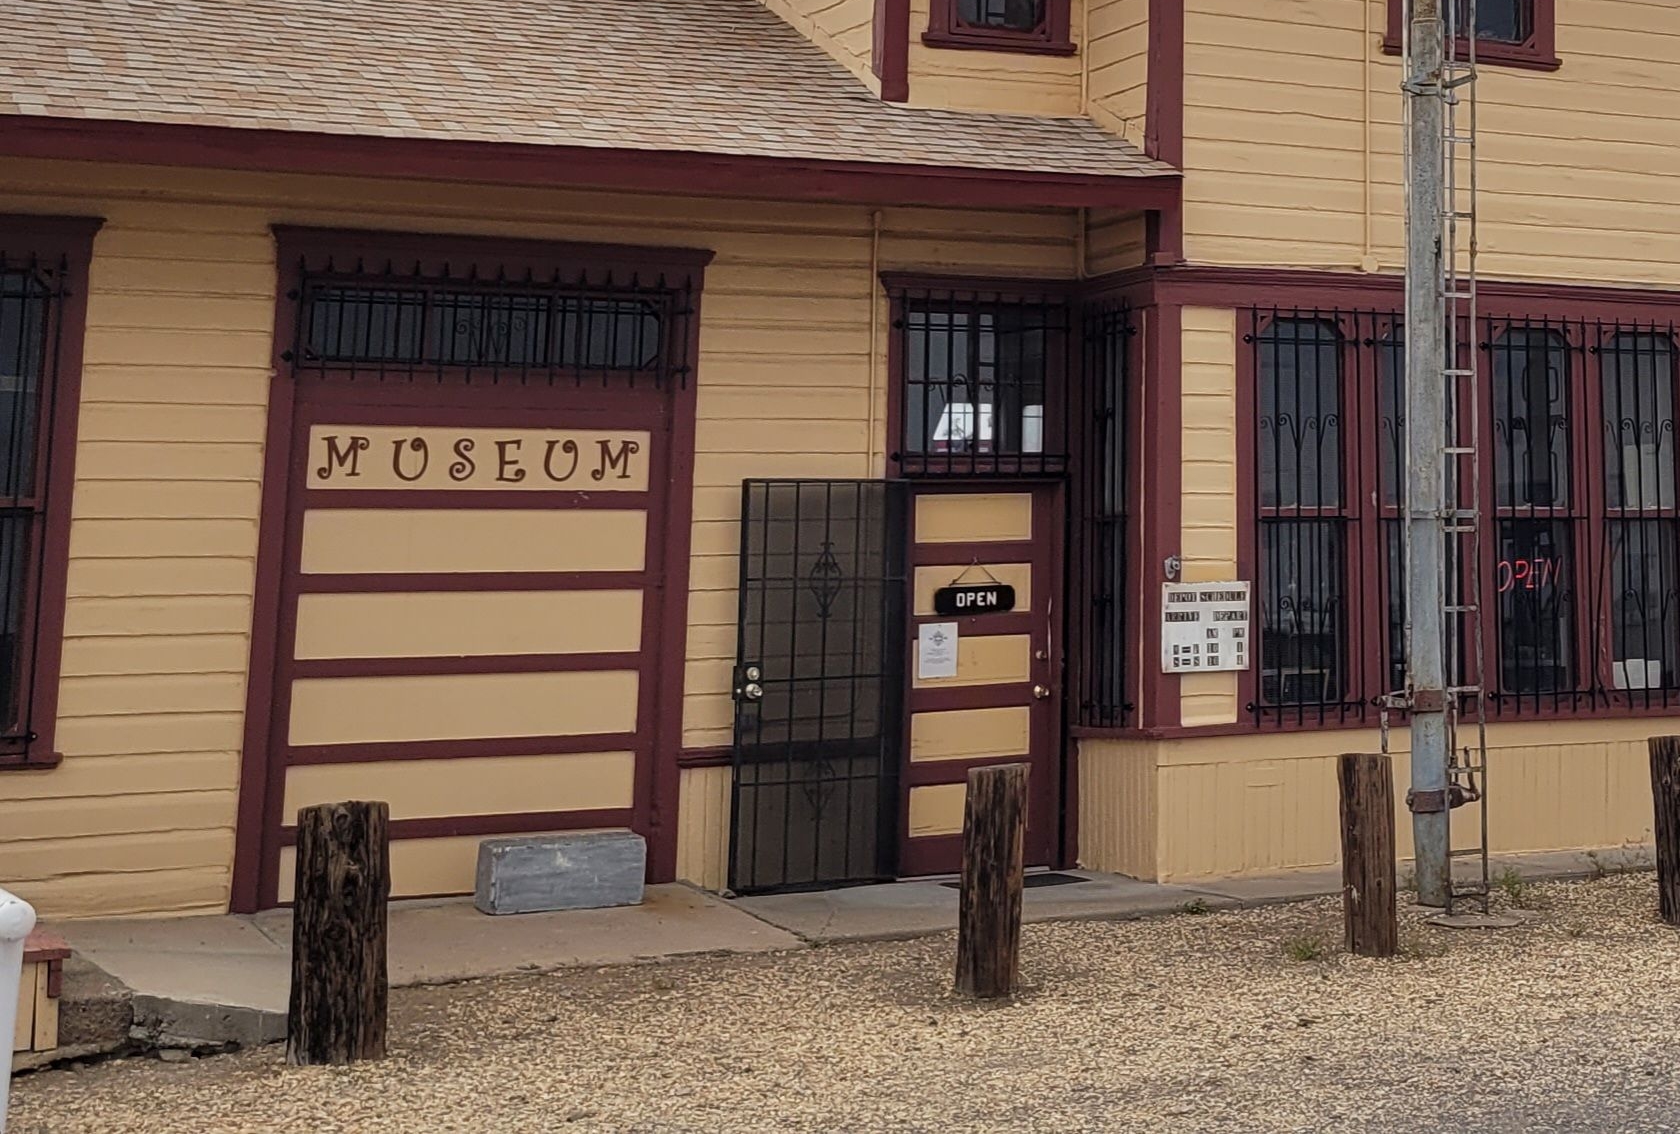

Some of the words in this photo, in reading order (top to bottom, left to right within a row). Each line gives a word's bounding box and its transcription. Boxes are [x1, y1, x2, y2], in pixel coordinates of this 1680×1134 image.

[317, 435, 640, 483] MUSEUM
[1498, 556, 1562, 592] OPEN
[956, 591, 997, 608] OPEN
[1168, 592, 1197, 603] DEPOT
